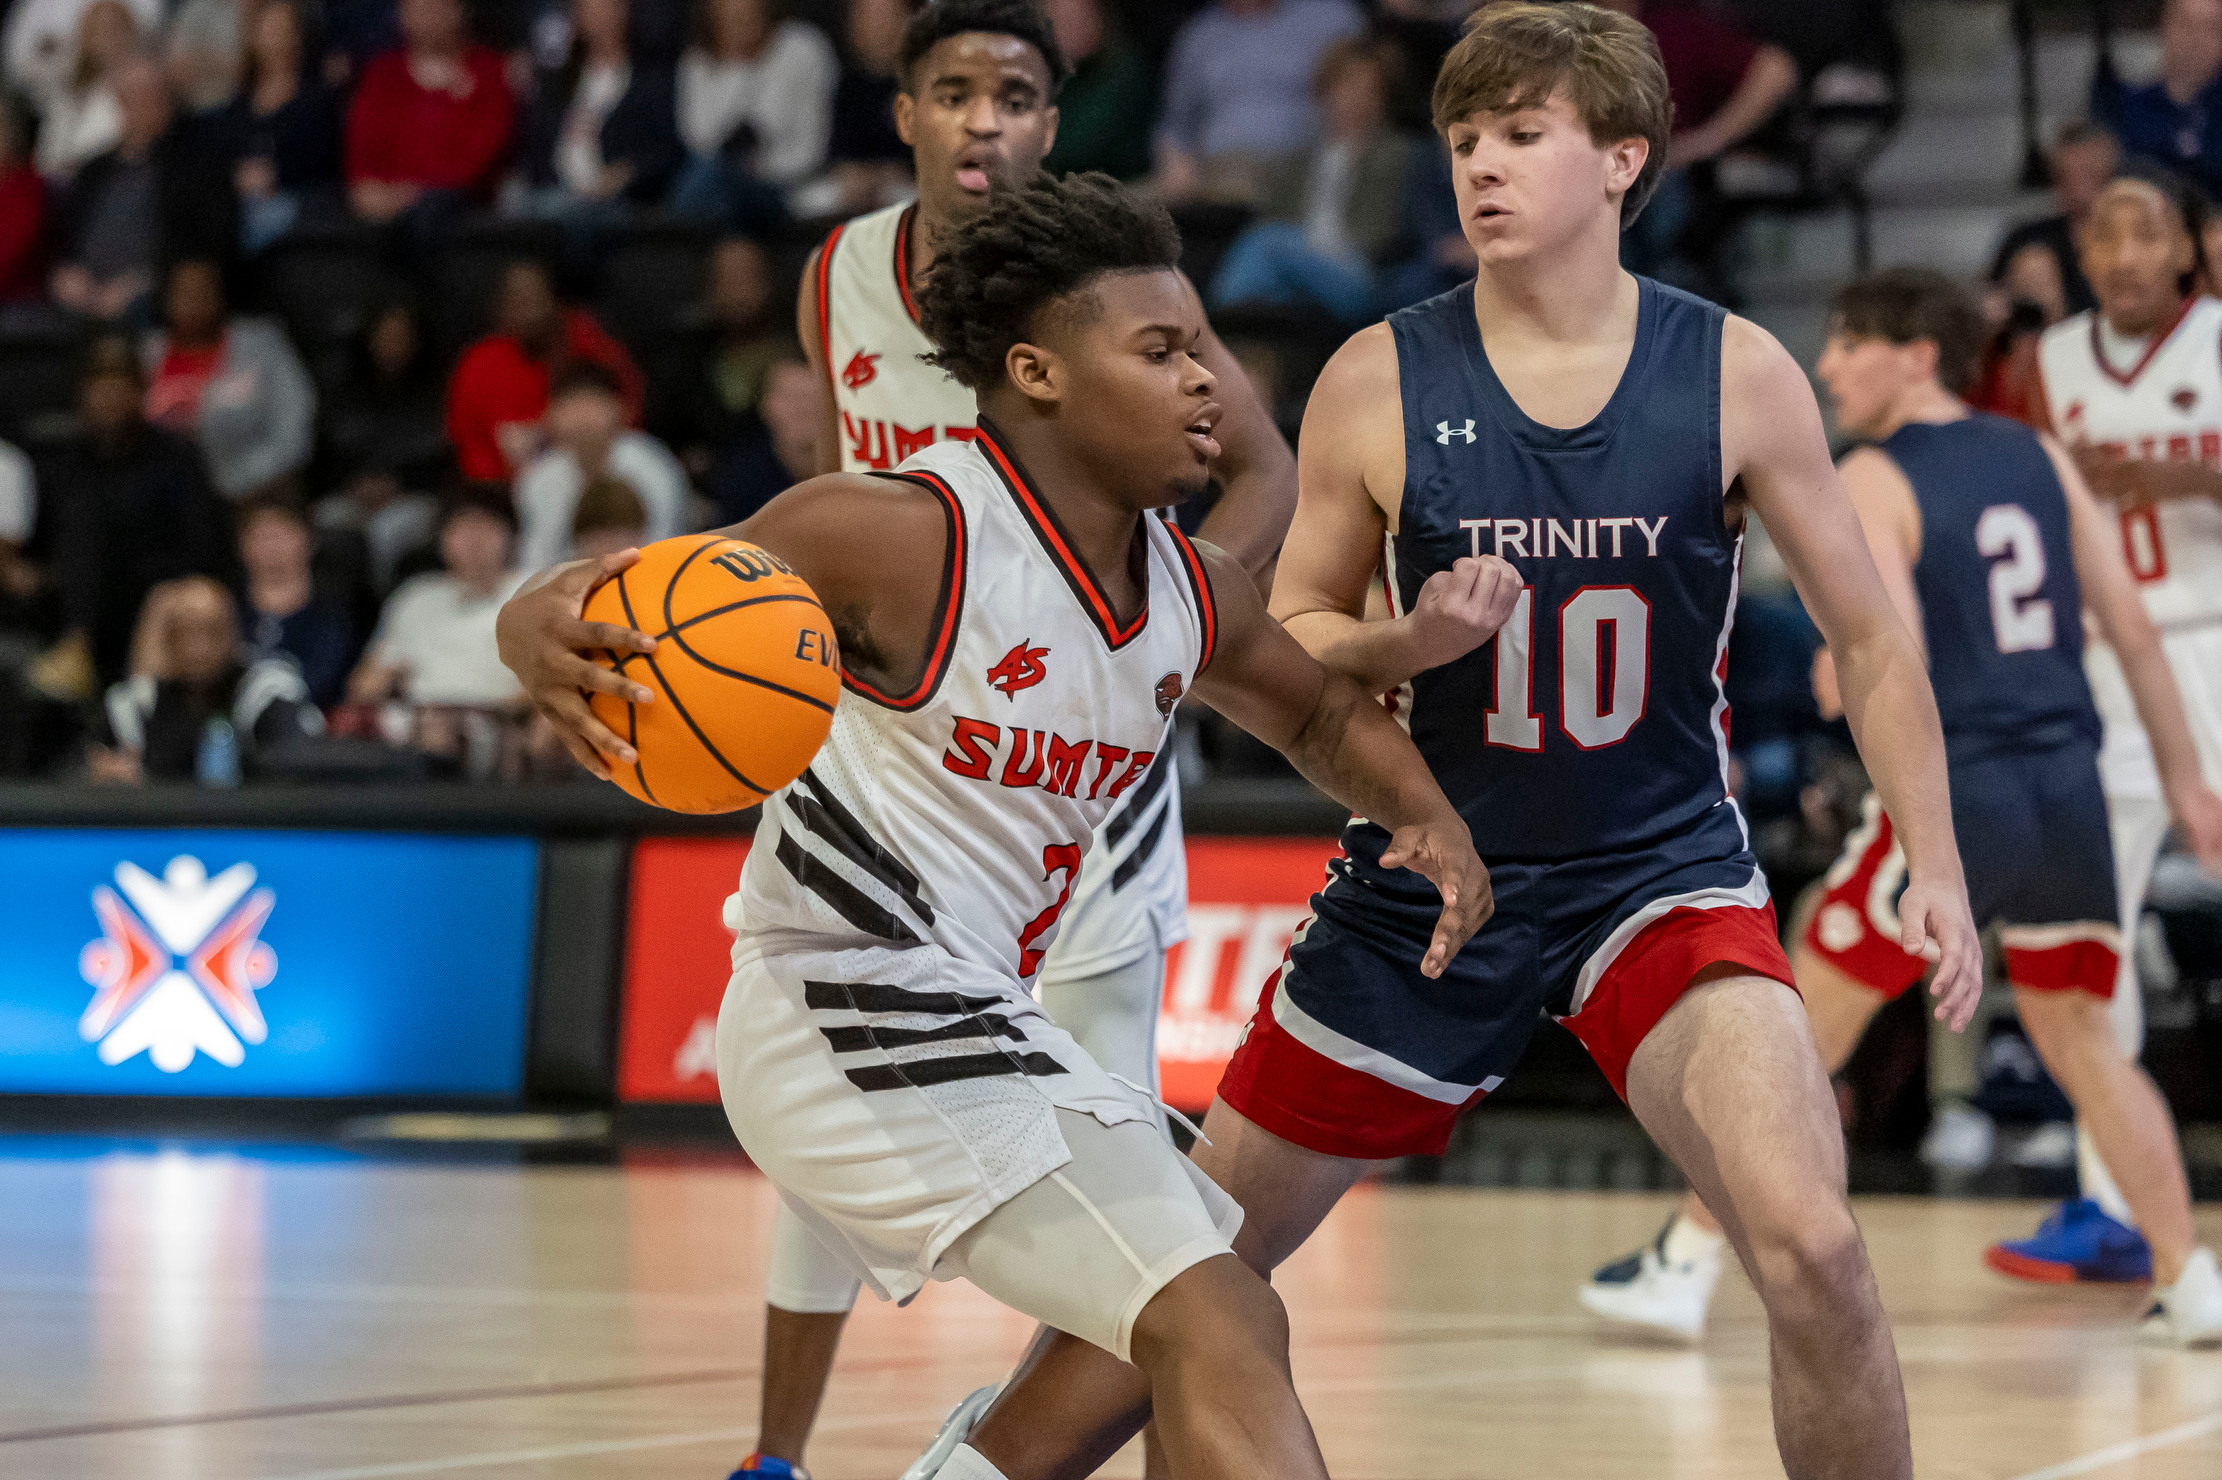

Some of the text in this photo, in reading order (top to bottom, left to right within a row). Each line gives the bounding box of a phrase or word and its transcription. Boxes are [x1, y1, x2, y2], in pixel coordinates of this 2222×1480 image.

[1458, 515, 1669, 559] TRINITY
[1974, 503, 2056, 655] 2
[1483, 583, 1651, 754] 10
[1016, 841, 1082, 979] 2
